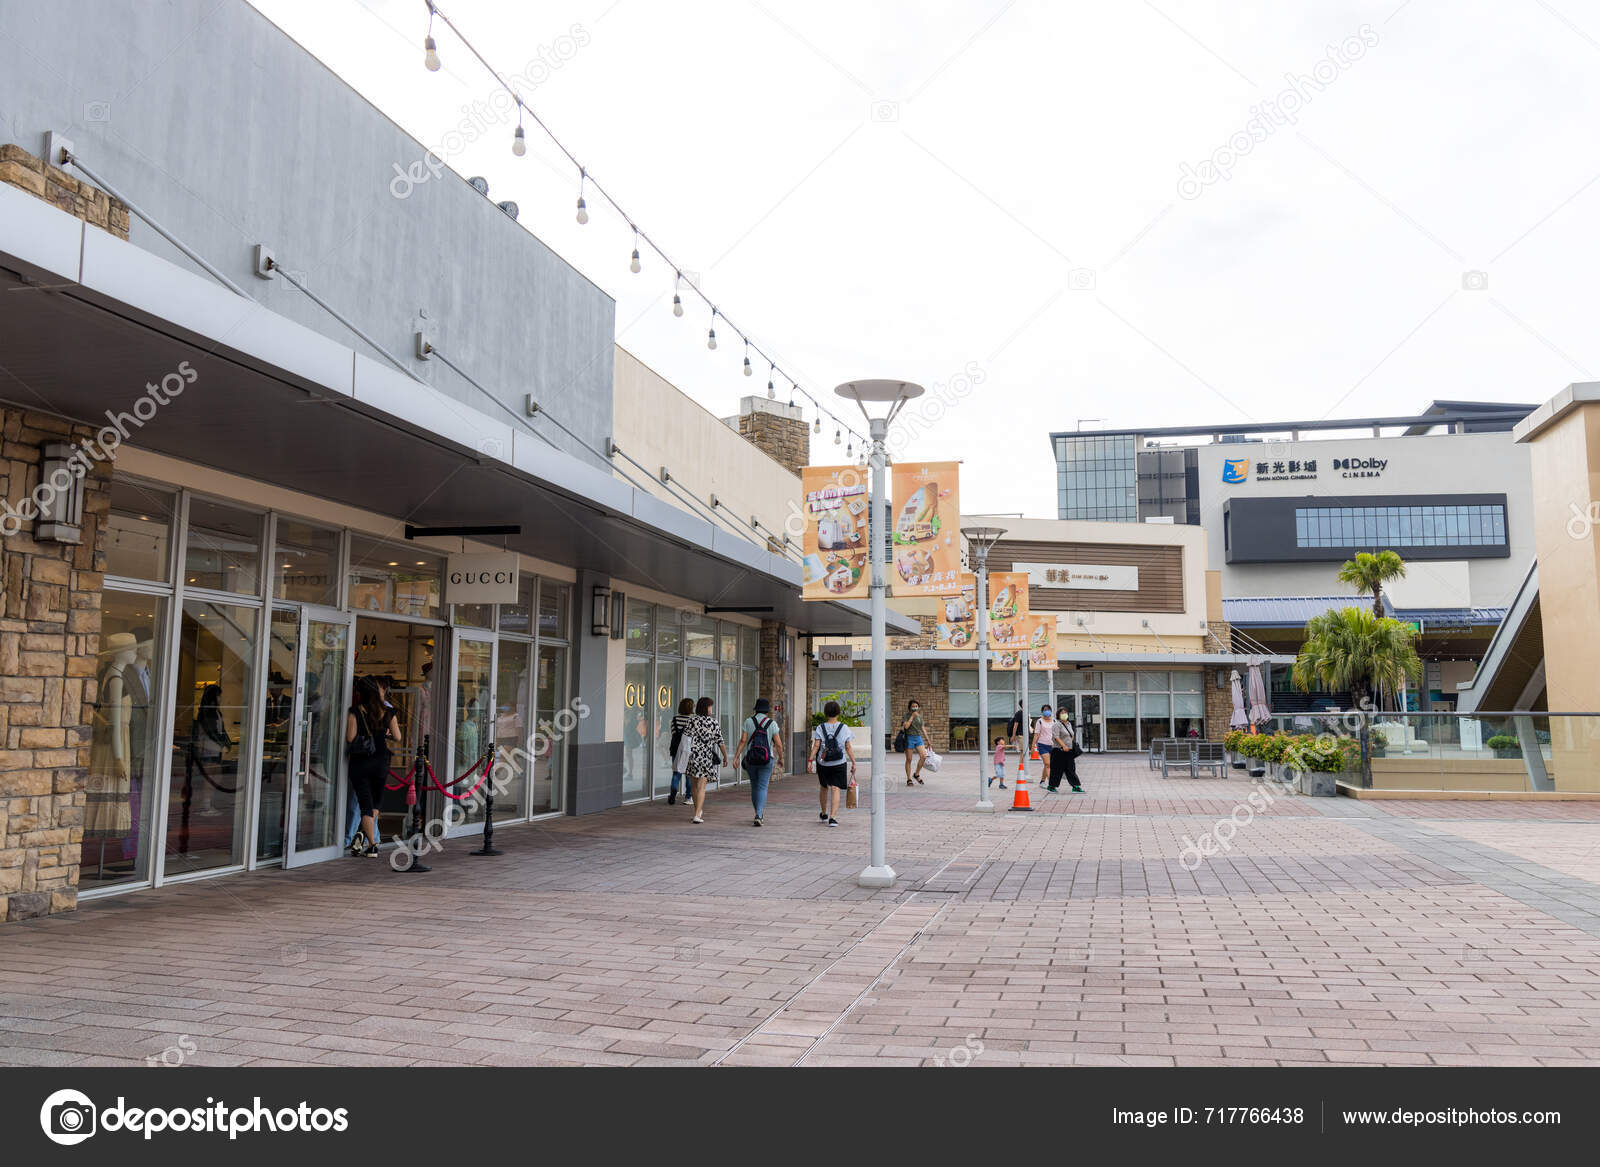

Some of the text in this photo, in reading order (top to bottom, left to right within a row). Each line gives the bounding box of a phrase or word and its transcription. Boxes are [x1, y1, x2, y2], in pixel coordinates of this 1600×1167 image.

[1256, 459, 1317, 475] 新光影城
[1351, 457, 1388, 471] Dolby
[1342, 471, 1381, 479] CINEMA
[450, 571, 514, 585] GUCCI
[821, 651, 849, 662] Chloé
